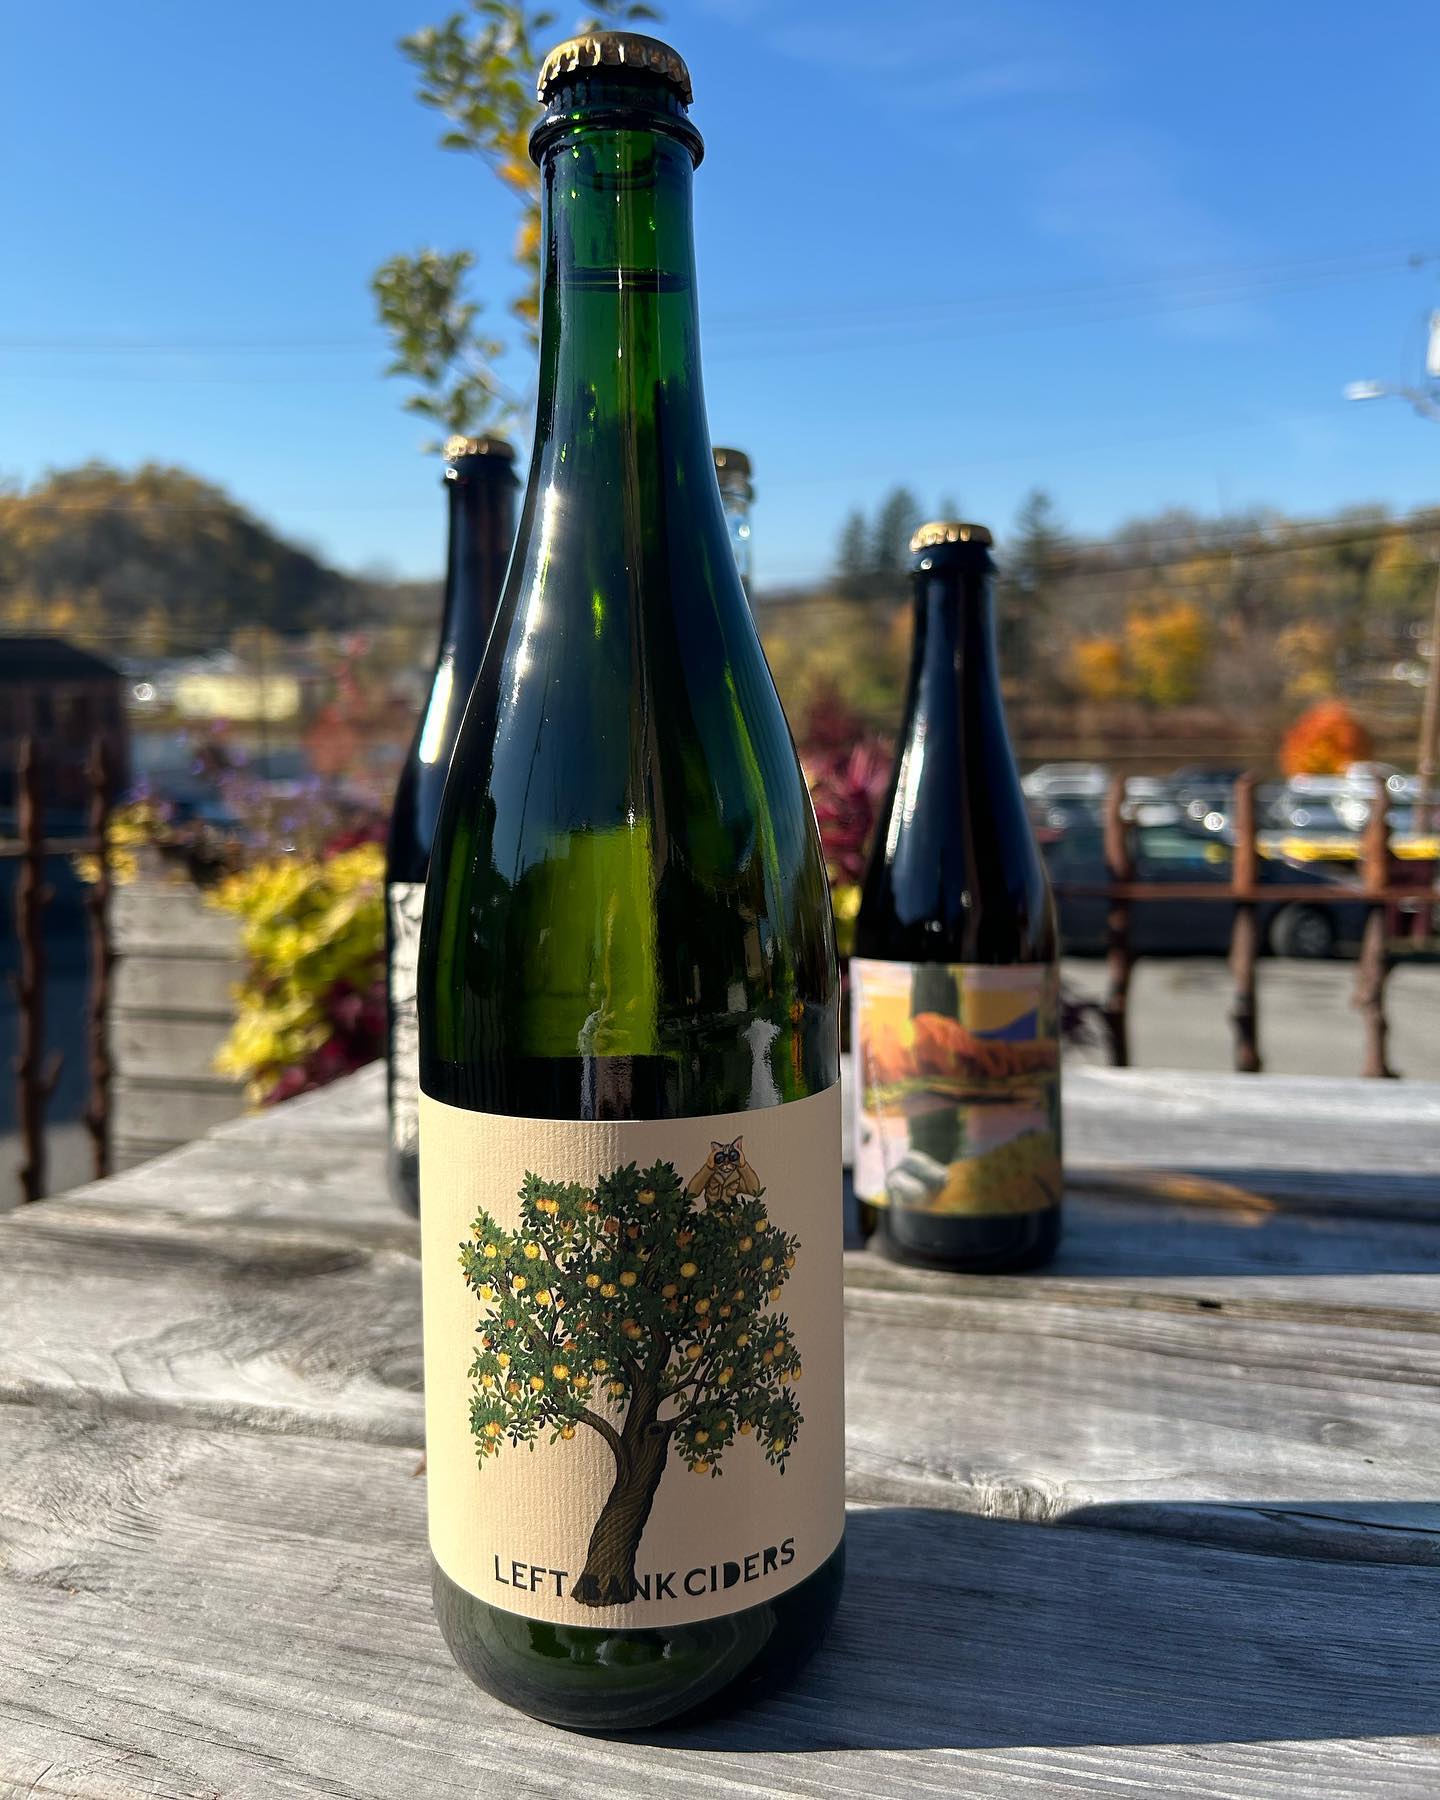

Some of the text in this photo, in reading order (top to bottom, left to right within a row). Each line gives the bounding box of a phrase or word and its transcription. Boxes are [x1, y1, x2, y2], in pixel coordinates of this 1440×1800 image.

[494, 1537, 795, 1601] LEFT BANK CIDERS
